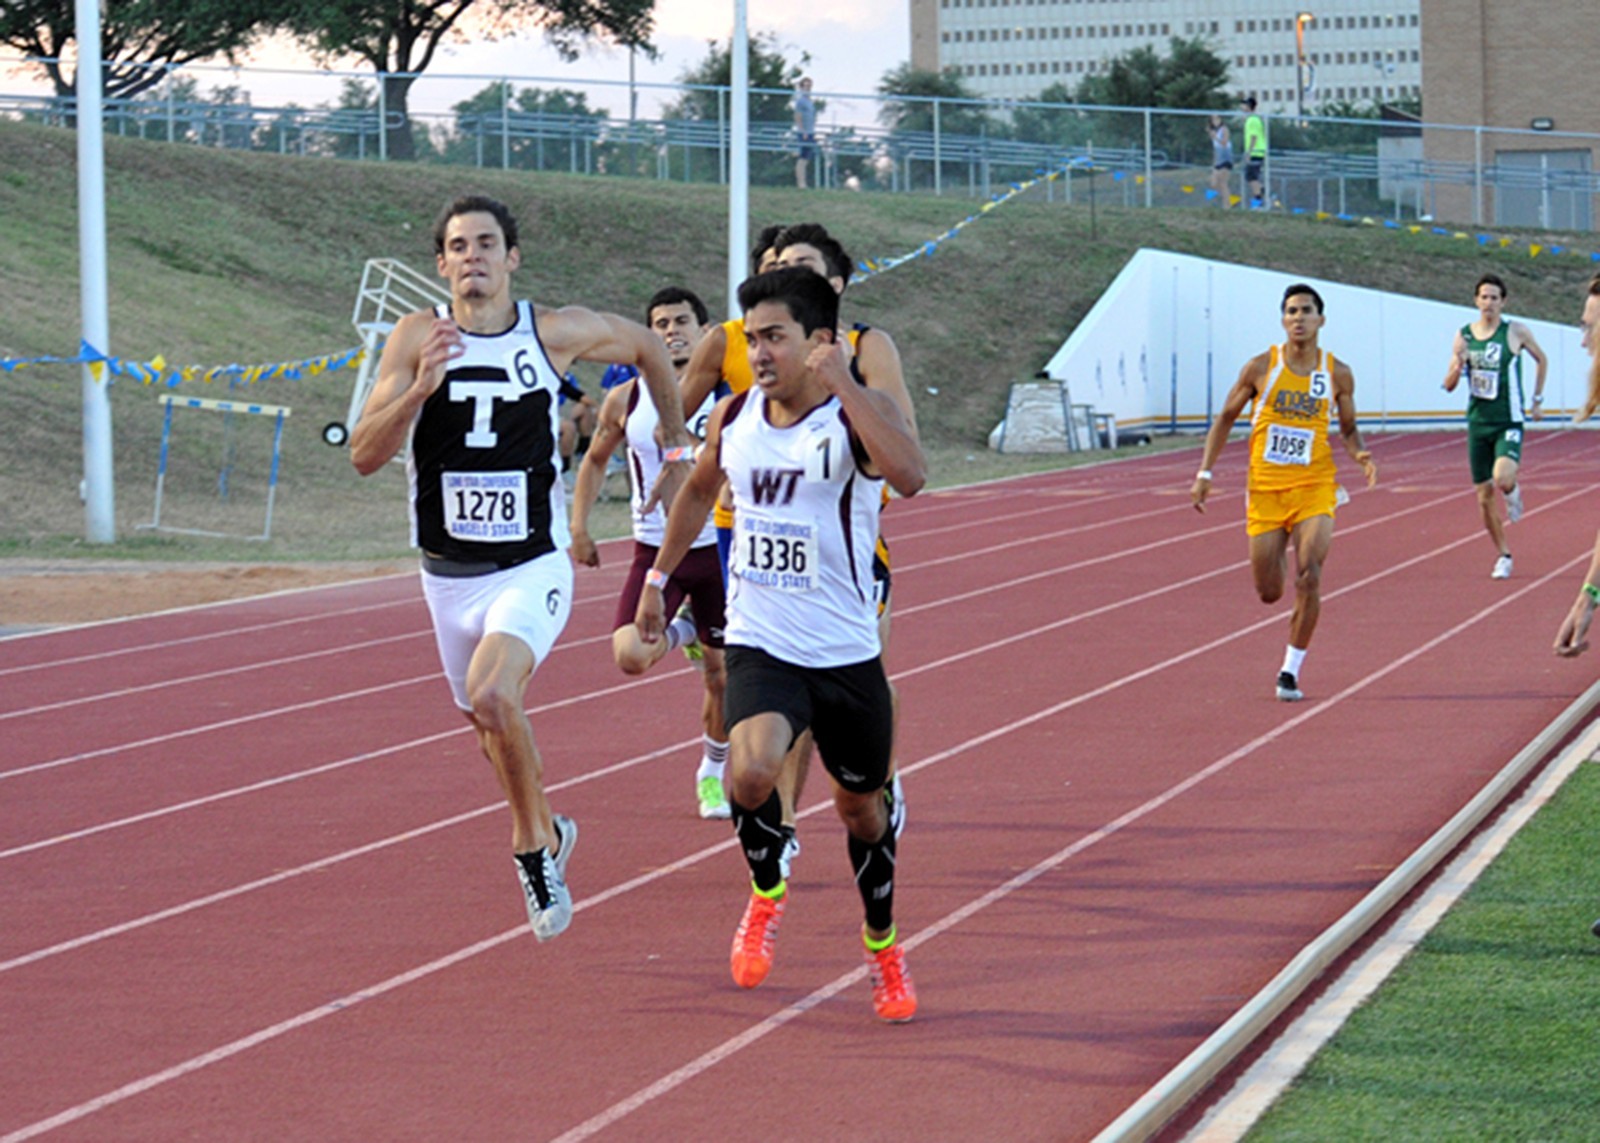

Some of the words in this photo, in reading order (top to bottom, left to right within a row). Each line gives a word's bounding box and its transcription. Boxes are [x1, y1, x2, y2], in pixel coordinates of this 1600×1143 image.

[1487, 342, 1498, 360] 2
[514, 349, 537, 388] 6
[1312, 373, 1326, 396] 5
[449, 381, 520, 447] T
[816, 437, 831, 479] 1
[481, 475, 520, 488] CONFERENCE
[751, 467, 805, 505] WT
[455, 490, 516, 522] 1278
[451, 522, 488, 536] ANGELO
[491, 522, 521, 537] STATE
[748, 535, 806, 573] 1336
[781, 573, 812, 590] STATE
[546, 588, 560, 616] 6
